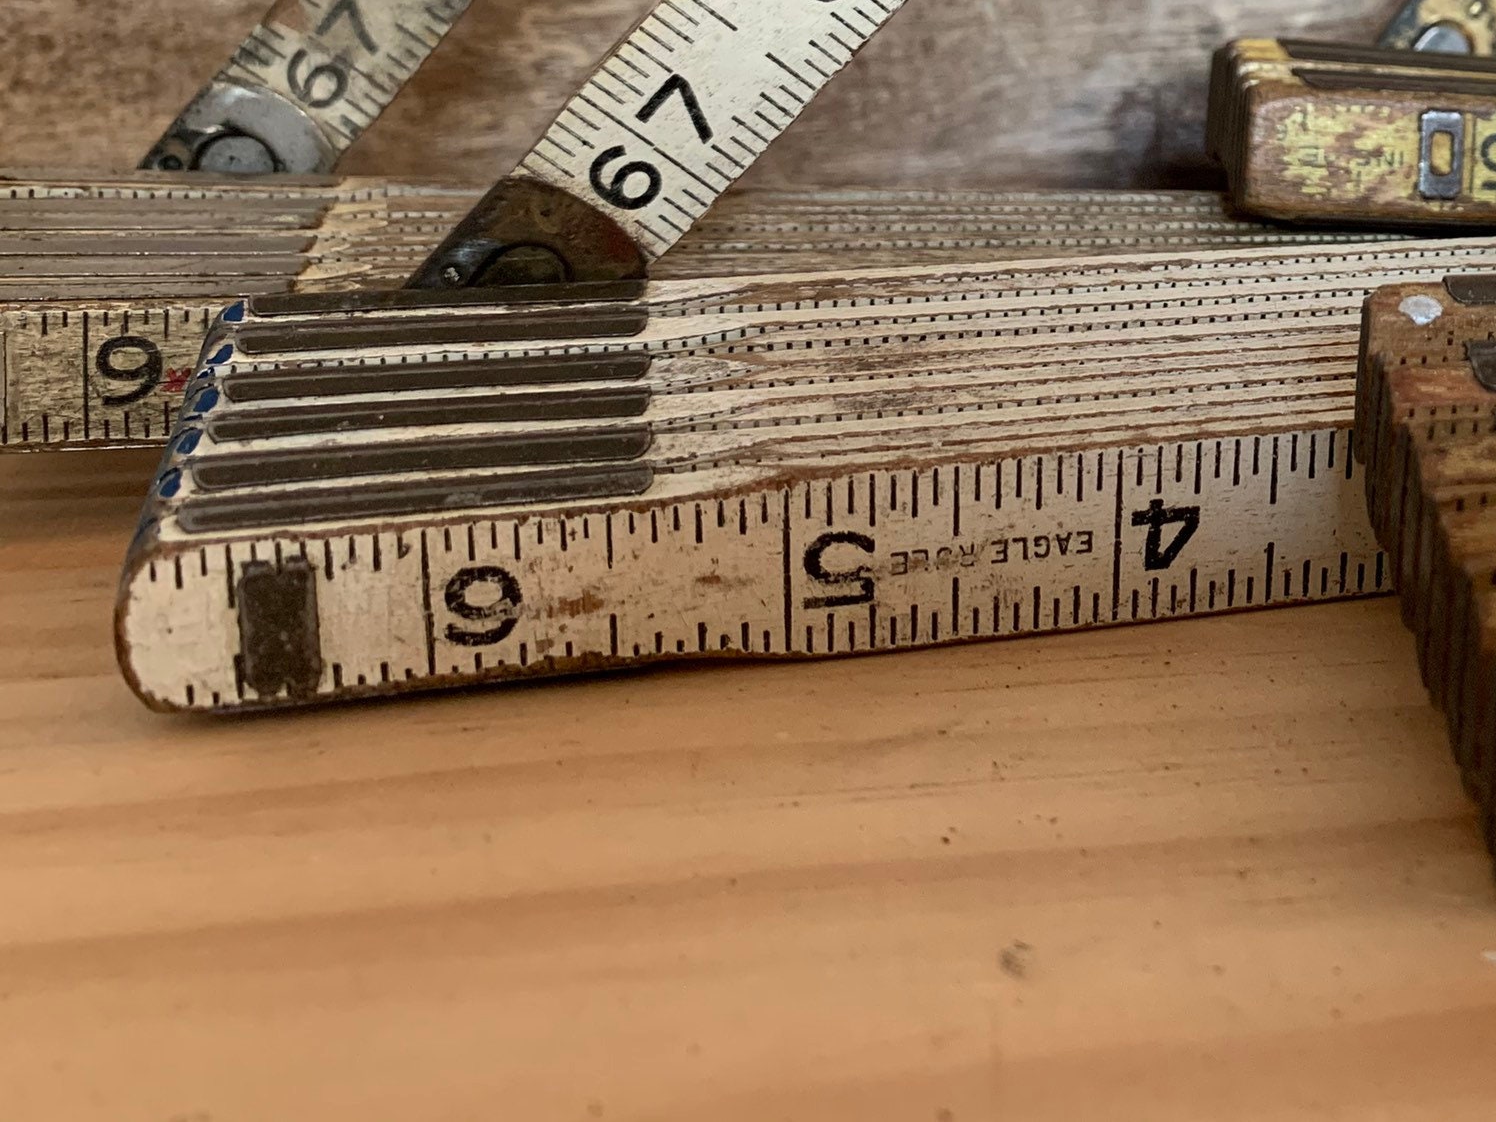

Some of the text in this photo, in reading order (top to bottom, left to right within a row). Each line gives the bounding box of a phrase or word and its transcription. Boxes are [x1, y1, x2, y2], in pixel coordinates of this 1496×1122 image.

[589, 74, 713, 210] 67
[802, 530, 876, 610] 5
[992, 529, 1094, 565] EAGLE
[1131, 498, 1200, 570] 4
